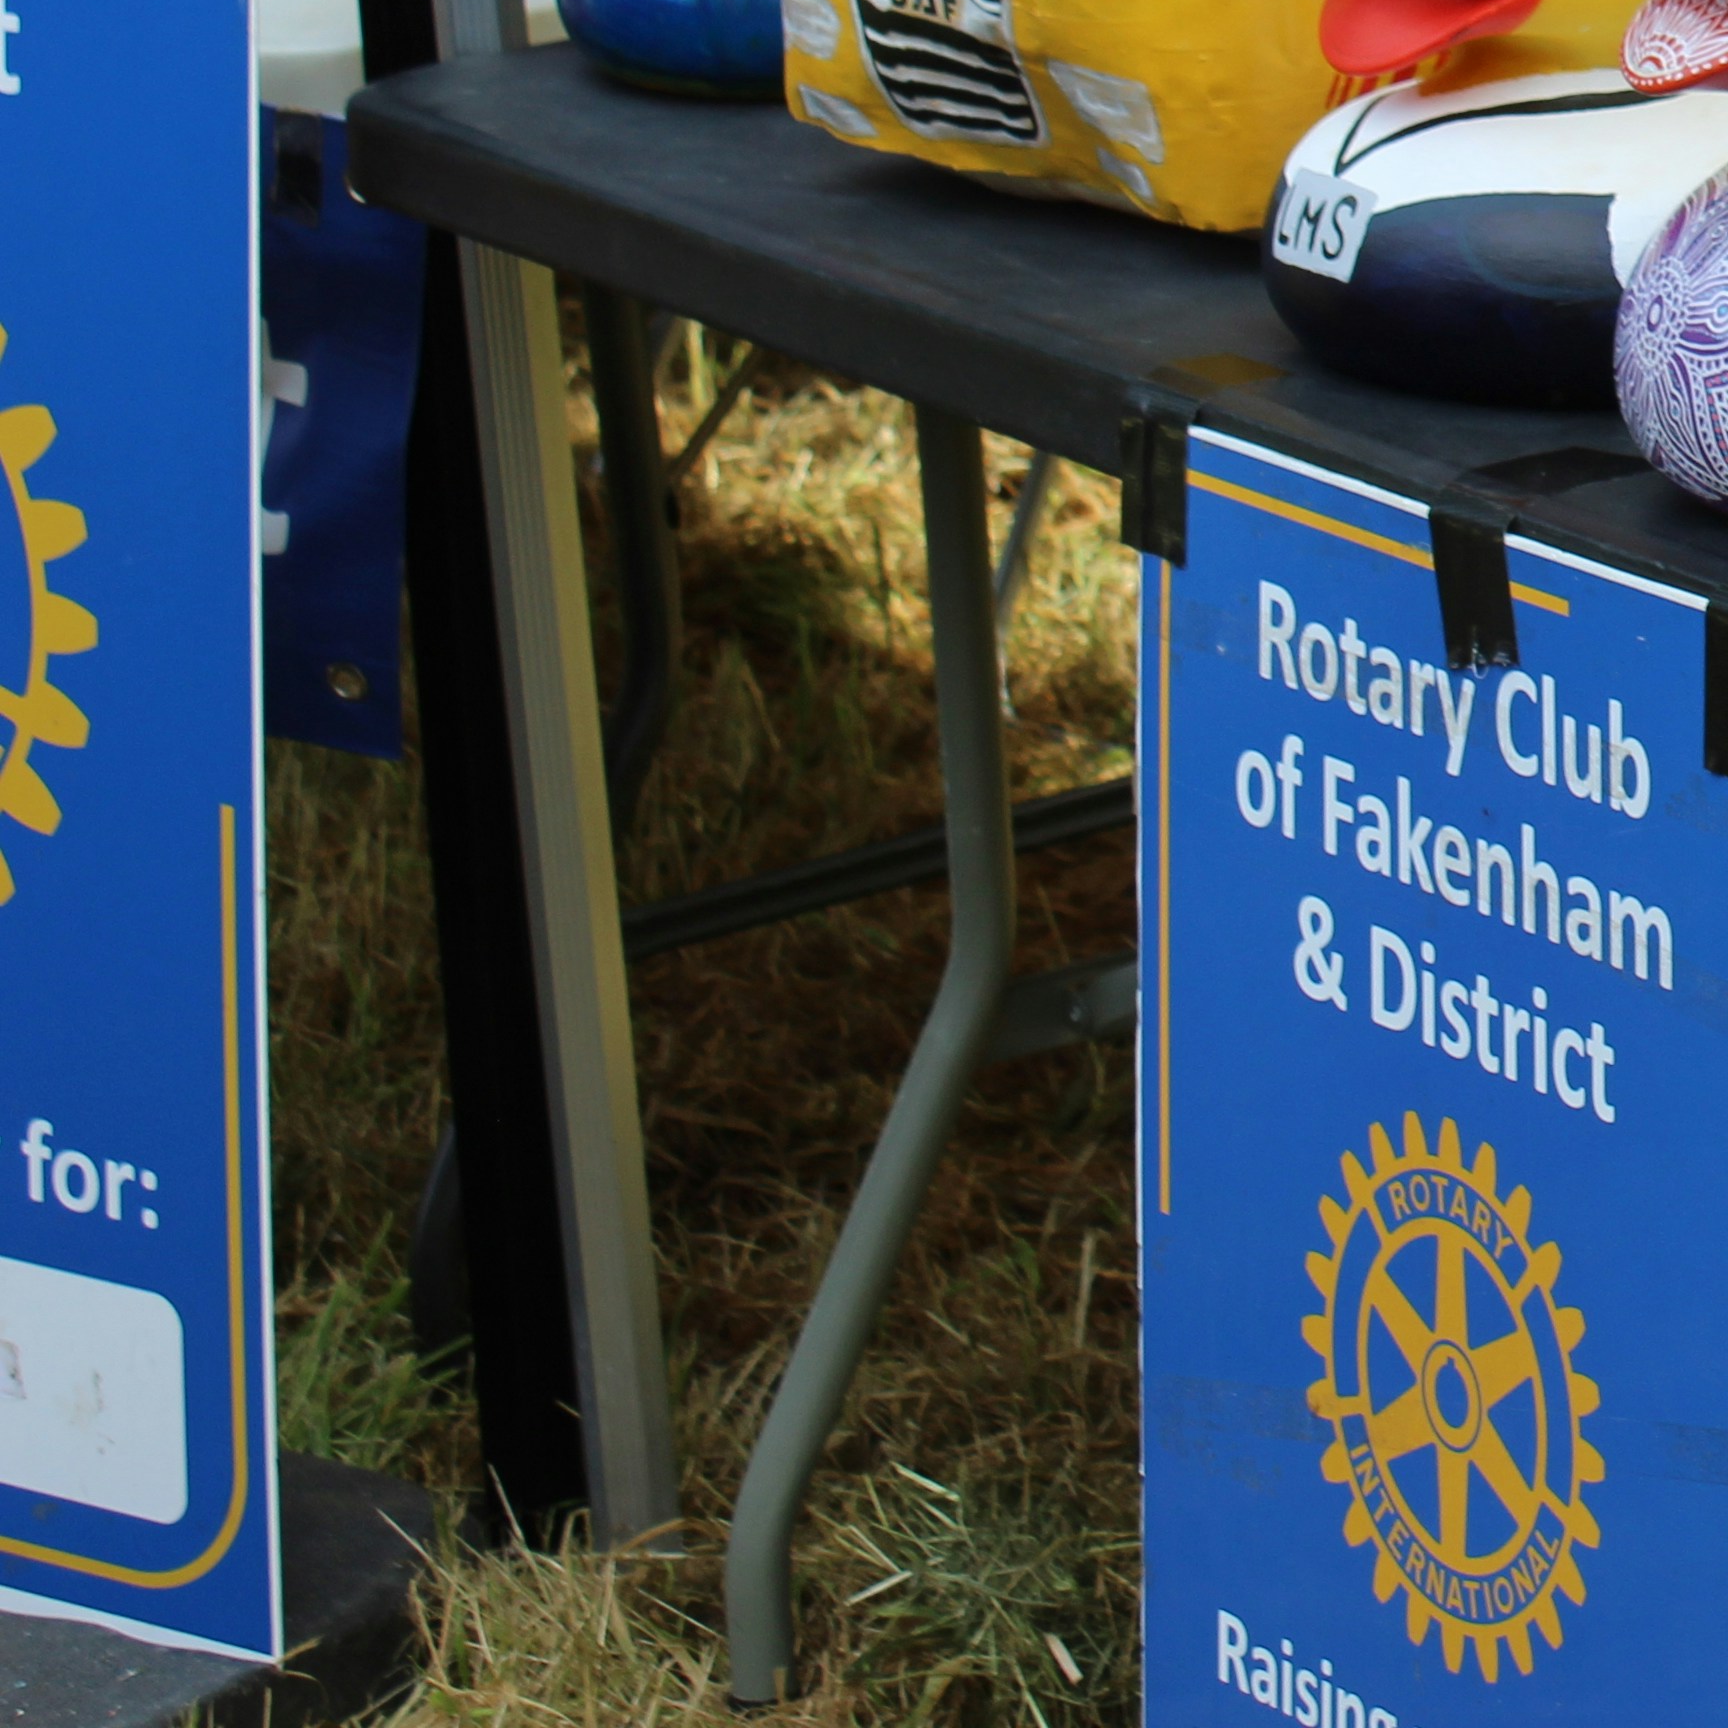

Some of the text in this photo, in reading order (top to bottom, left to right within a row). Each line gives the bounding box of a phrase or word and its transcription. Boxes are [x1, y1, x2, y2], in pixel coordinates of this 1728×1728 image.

[1278, 184, 1358, 260] LMS
[1258, 579, 1652, 820] Rotary Club
[1234, 732, 1674, 991] of Fakenham
[1292, 894, 1616, 1124] & District
[19, 1117, 159, 1229] for:
[1390, 1173, 1514, 1260] ROTARY
[1349, 1441, 1560, 1620] INTERNATIONAL
